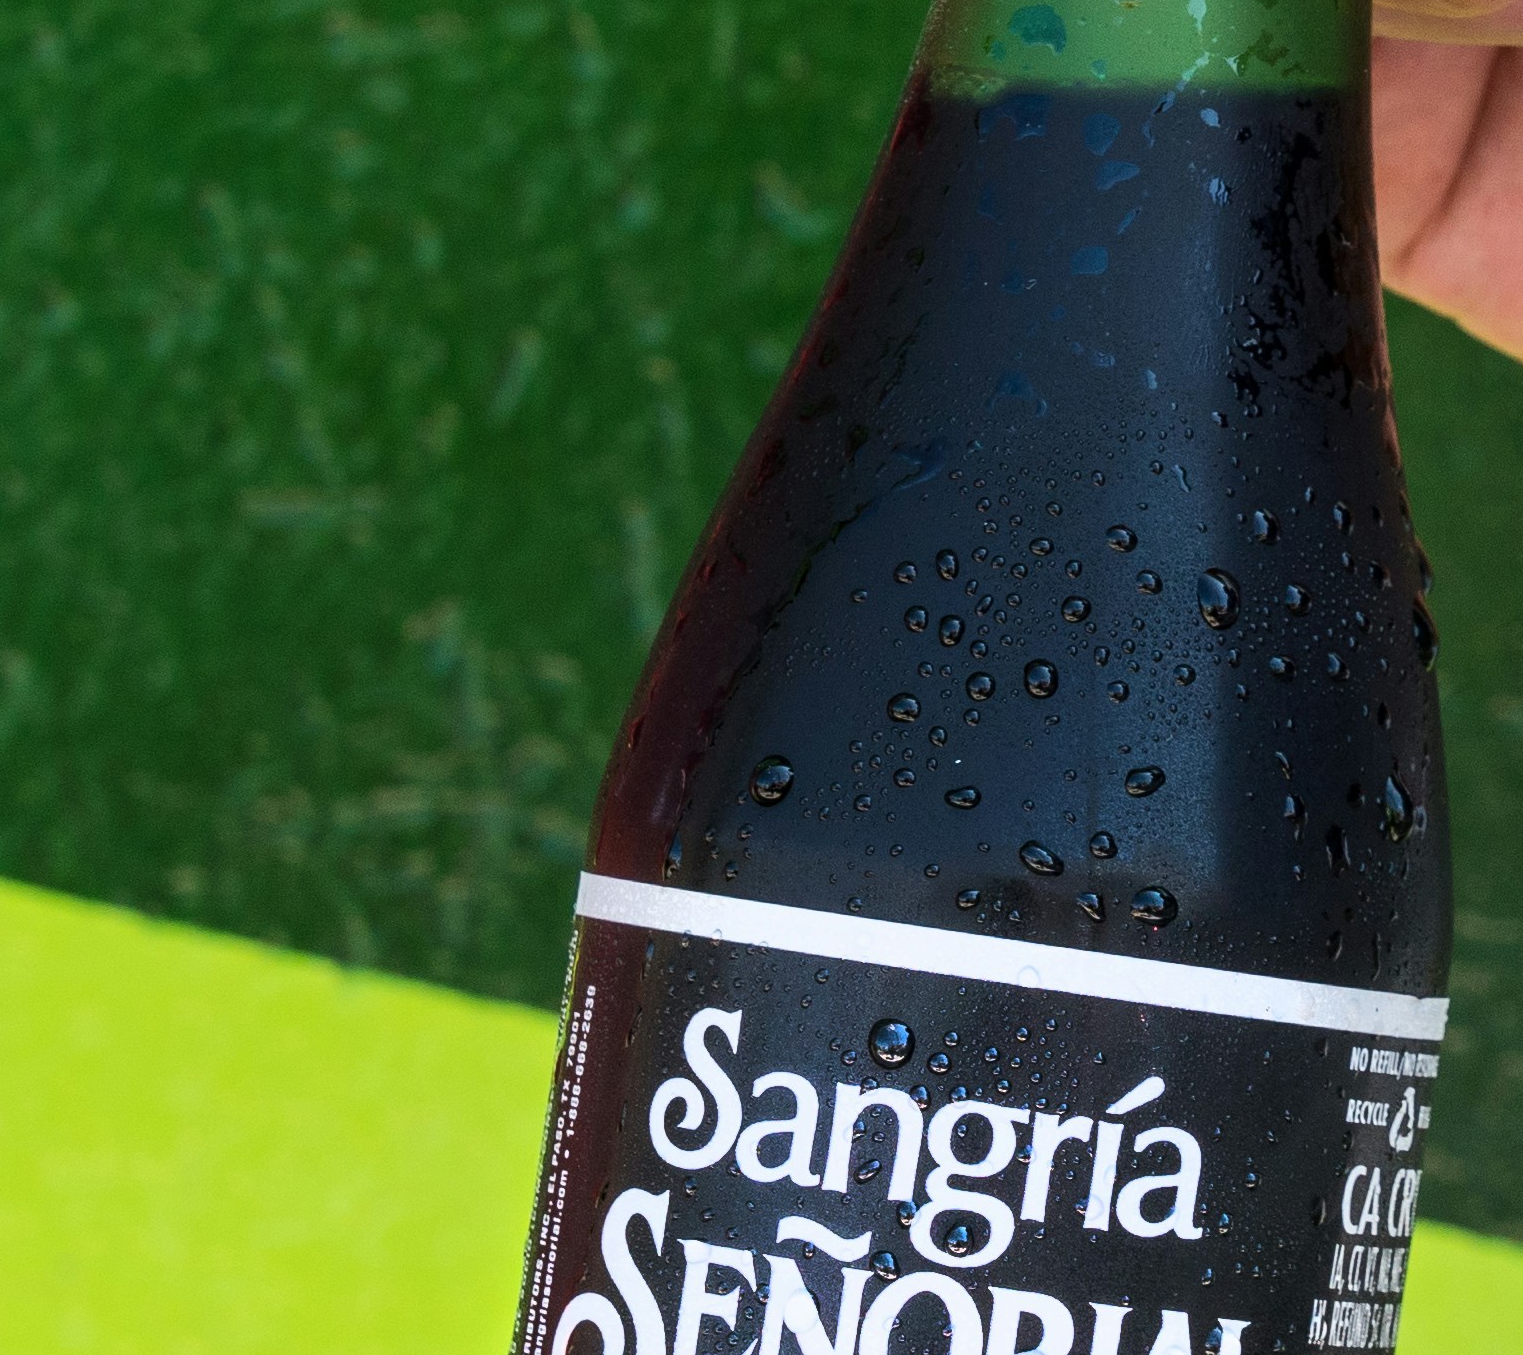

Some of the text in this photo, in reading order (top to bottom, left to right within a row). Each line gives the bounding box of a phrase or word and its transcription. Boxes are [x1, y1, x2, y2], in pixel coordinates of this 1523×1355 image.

[546, 1172, 558, 1194] EL
[560, 1078, 571, 1103] TX
[648, 1007, 1204, 1268] Sangría
[1345, 1098, 1390, 1127] RECYCLE
[1341, 1164, 1381, 1236] CA
